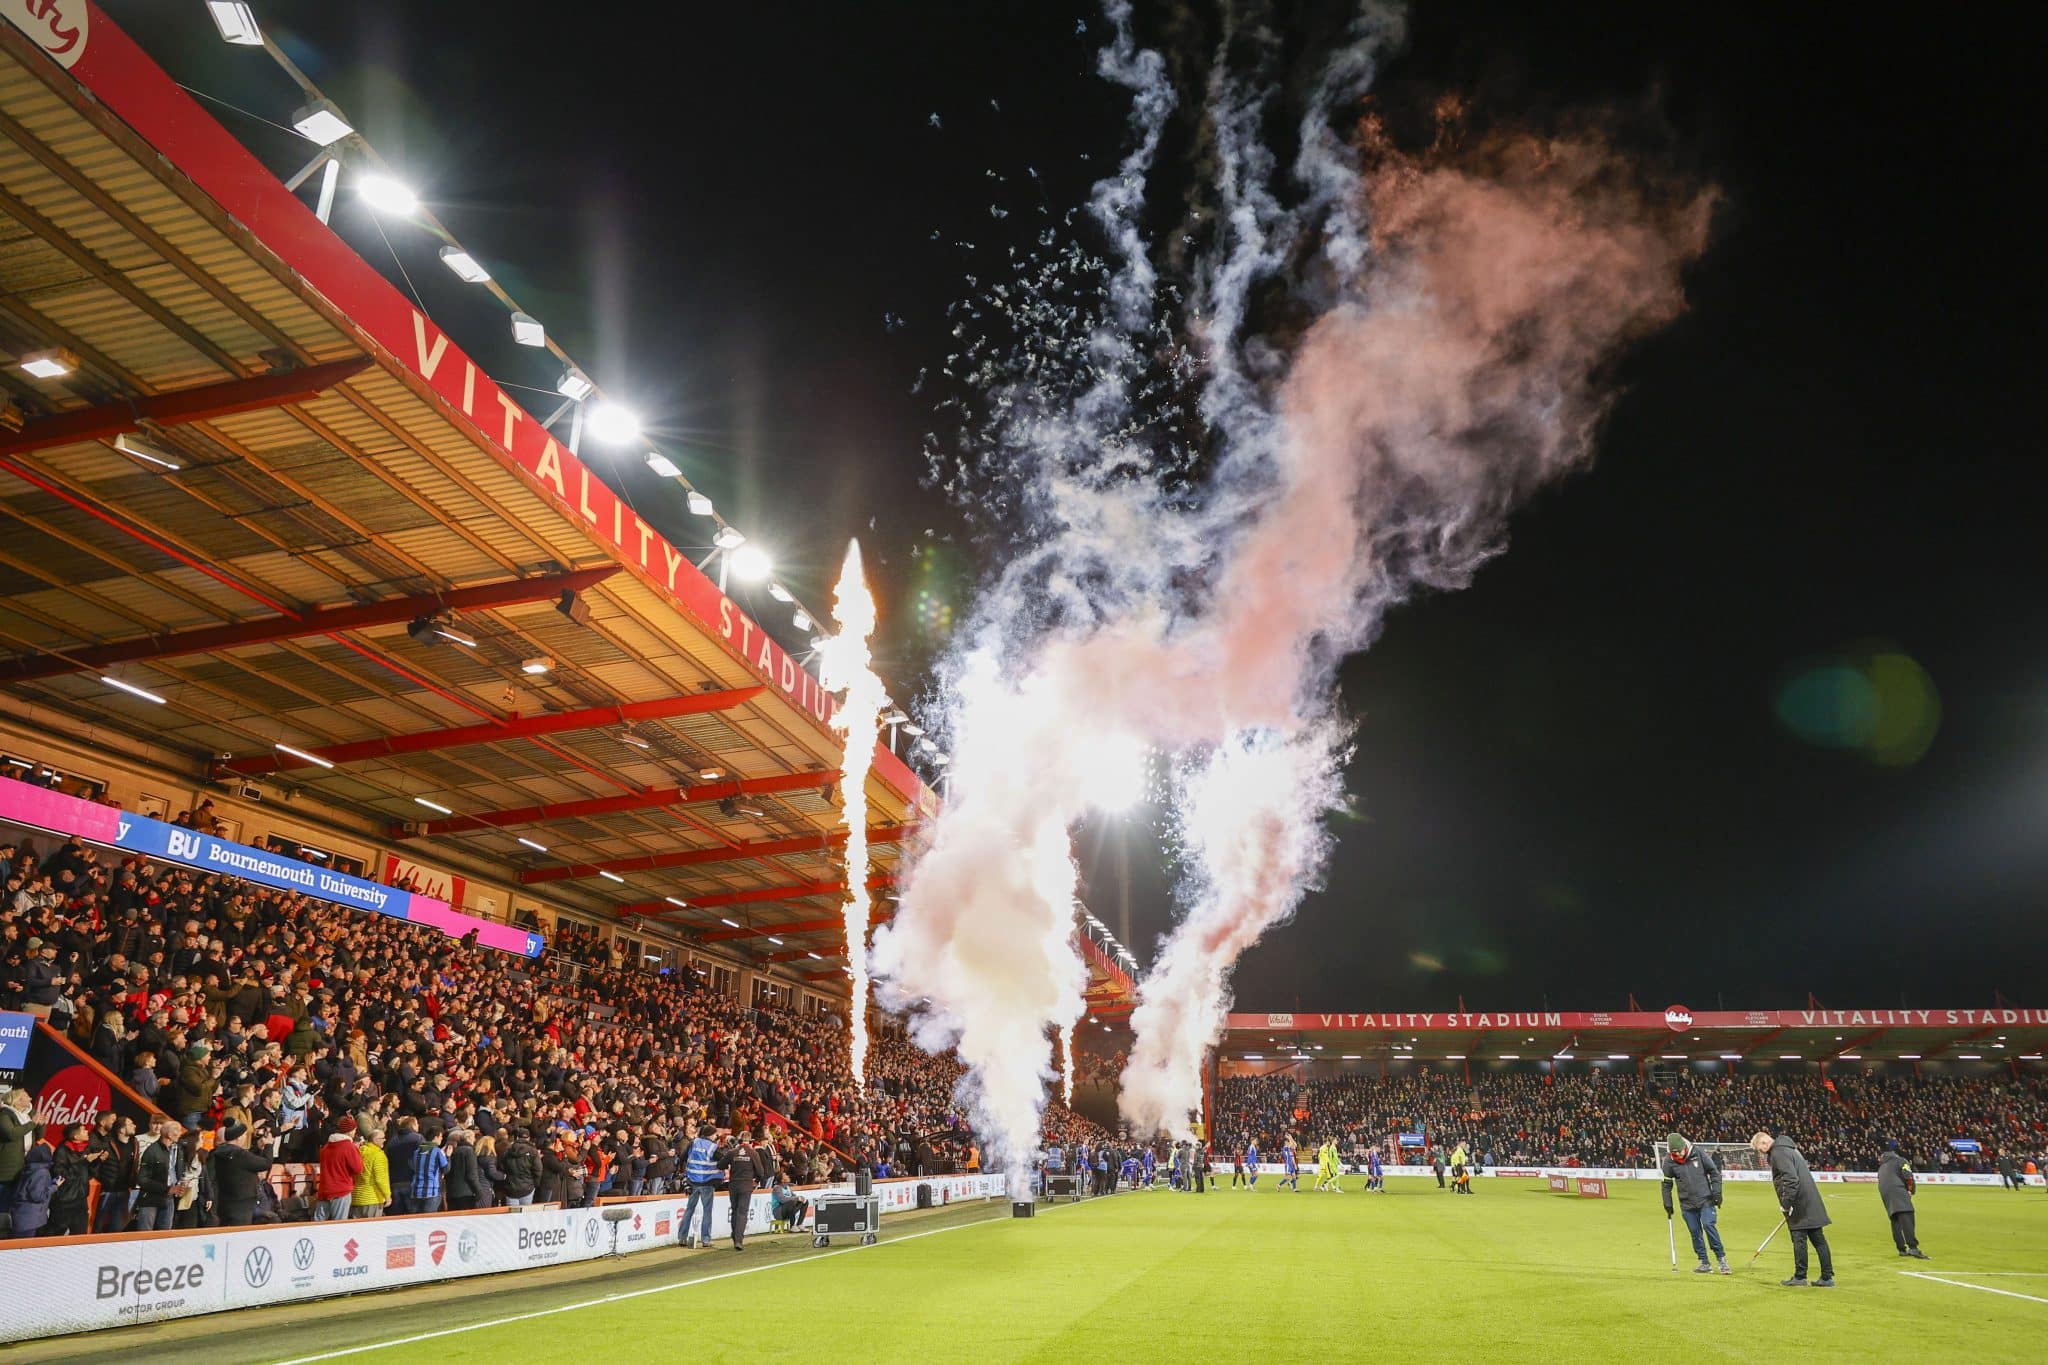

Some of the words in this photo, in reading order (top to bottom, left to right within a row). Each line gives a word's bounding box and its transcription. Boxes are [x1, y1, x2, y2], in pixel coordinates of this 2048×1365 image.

[412, 309, 682, 591] VITALITY
[167, 829, 201, 860] BU
[209, 843, 315, 888] Bournemouth
[320, 874, 388, 909] University
[1320, 1014, 1434, 1028] VITALITY
[1447, 1013, 1561, 1027] STADIUM
[1665, 1010, 1693, 1025] Vitality
[1801, 1010, 1931, 1025] VITALITY
[1946, 1010, 2048, 1024] STADIU
[37, 1089, 99, 1126] Vitalit
[519, 1228, 567, 1250] Breeze
[333, 1265, 369, 1278] SUZUKI
[96, 1263, 204, 1300] Breeze
[119, 1304, 153, 1316] MOTOR
[155, 1299, 185, 1311] GROUP
